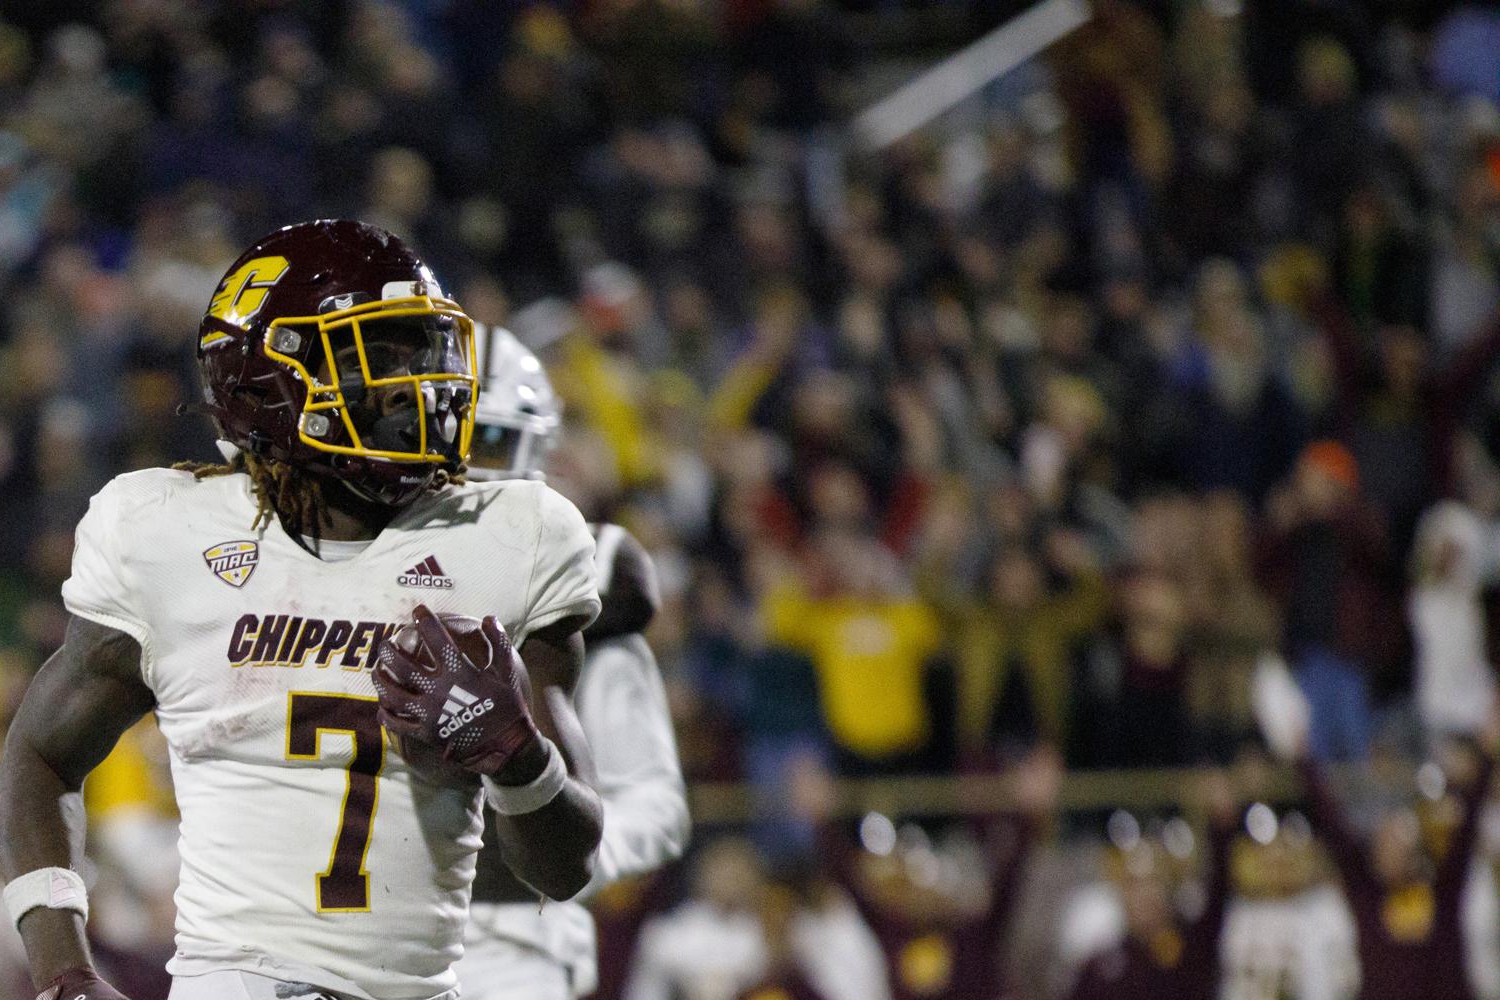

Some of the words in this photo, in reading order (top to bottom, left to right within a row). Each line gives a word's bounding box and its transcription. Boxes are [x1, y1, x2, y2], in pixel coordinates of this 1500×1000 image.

[208, 551, 258, 573] MAC
[397, 574, 453, 588] adidas
[439, 697, 495, 739] adidas
[285, 690, 387, 913] 7
